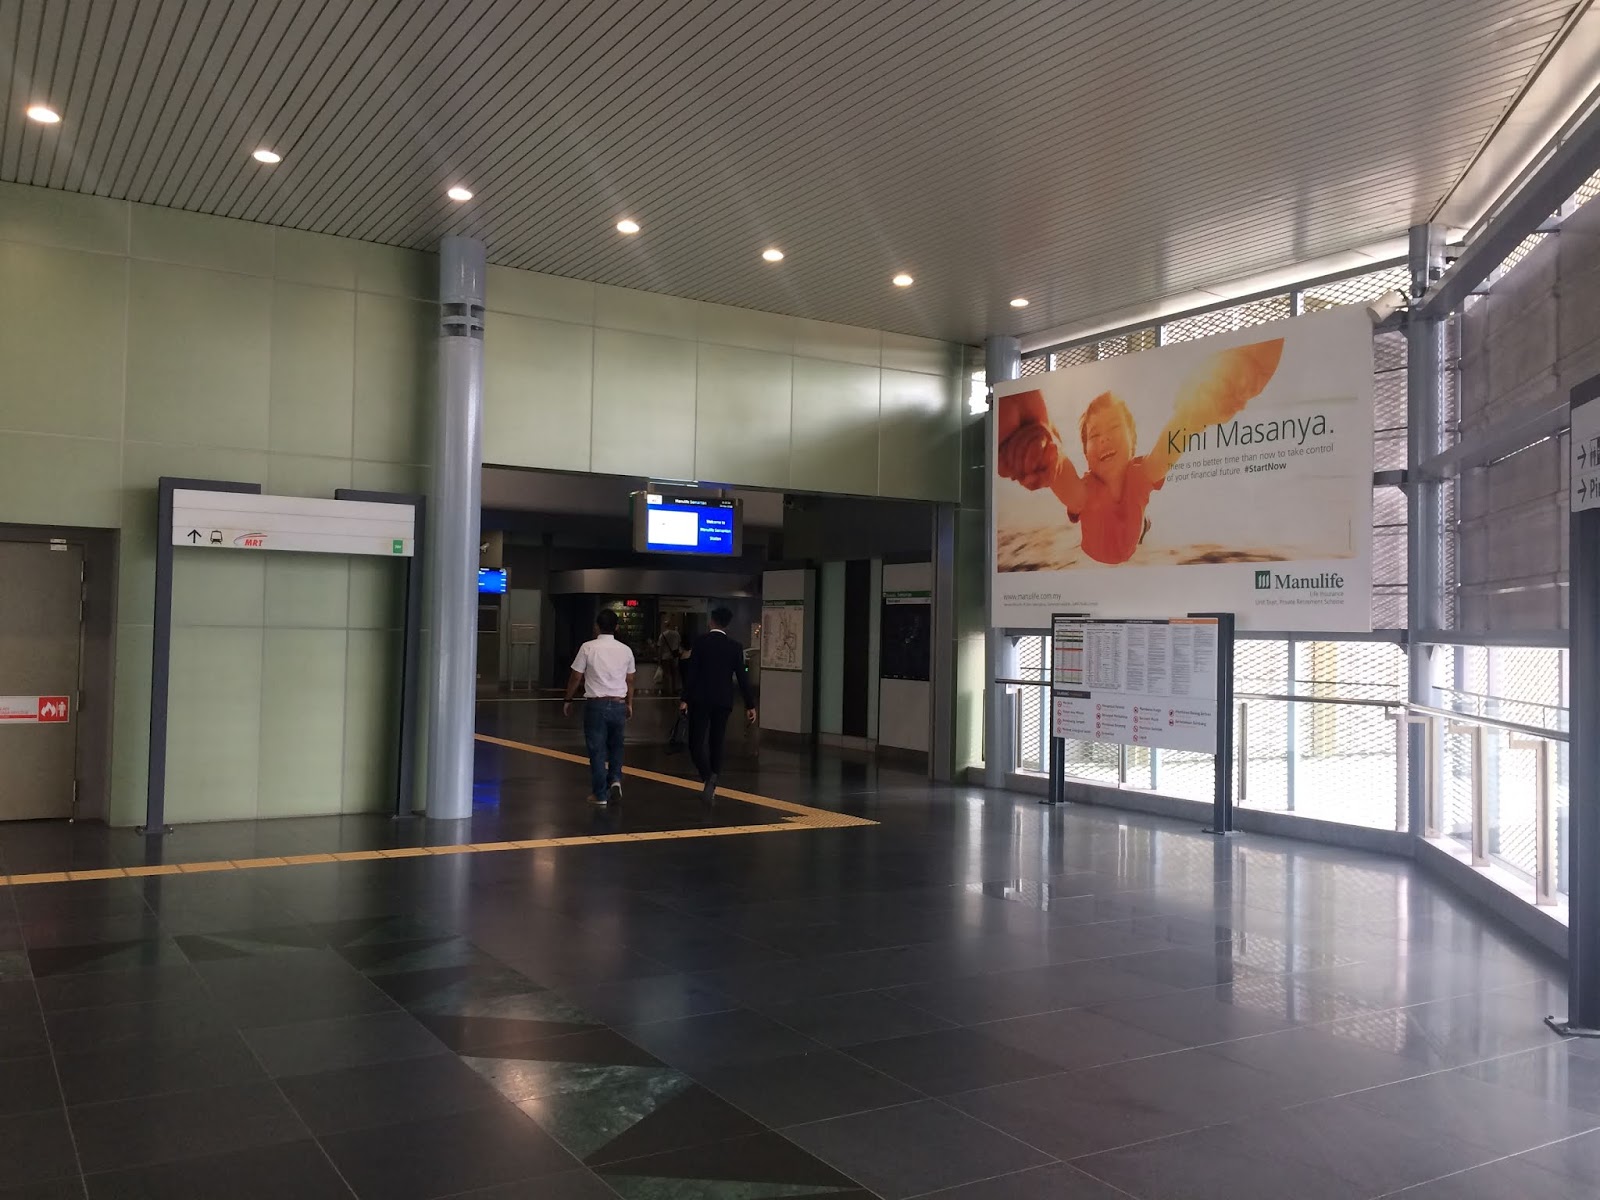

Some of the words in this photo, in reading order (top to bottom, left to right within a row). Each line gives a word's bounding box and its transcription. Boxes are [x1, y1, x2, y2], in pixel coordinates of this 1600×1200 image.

[1168, 425, 1207, 454] Kini
[1216, 413, 1335, 449] Masanya.
[1168, 462, 1185, 471] There
[1186, 461, 1191, 469] is
[1192, 460, 1201, 468] no
[1203, 457, 1223, 467] better
[1224, 455, 1240, 464] time
[1241, 452, 1258, 462] than
[1259, 451, 1276, 461] now
[1277, 449, 1286, 458] to
[1287, 447, 1304, 456] take
[1305, 443, 1334, 455] control
[1166, 474, 1175, 482] of
[1175, 472, 1189, 483] your
[1190, 469, 1218, 479] financial
[1244, 462, 1287, 474] #StartNow
[244, 538, 263, 547] MRT
[1275, 573, 1344, 589] Manulife
[1003, 592, 1062, 601] www.manulife.com.my
